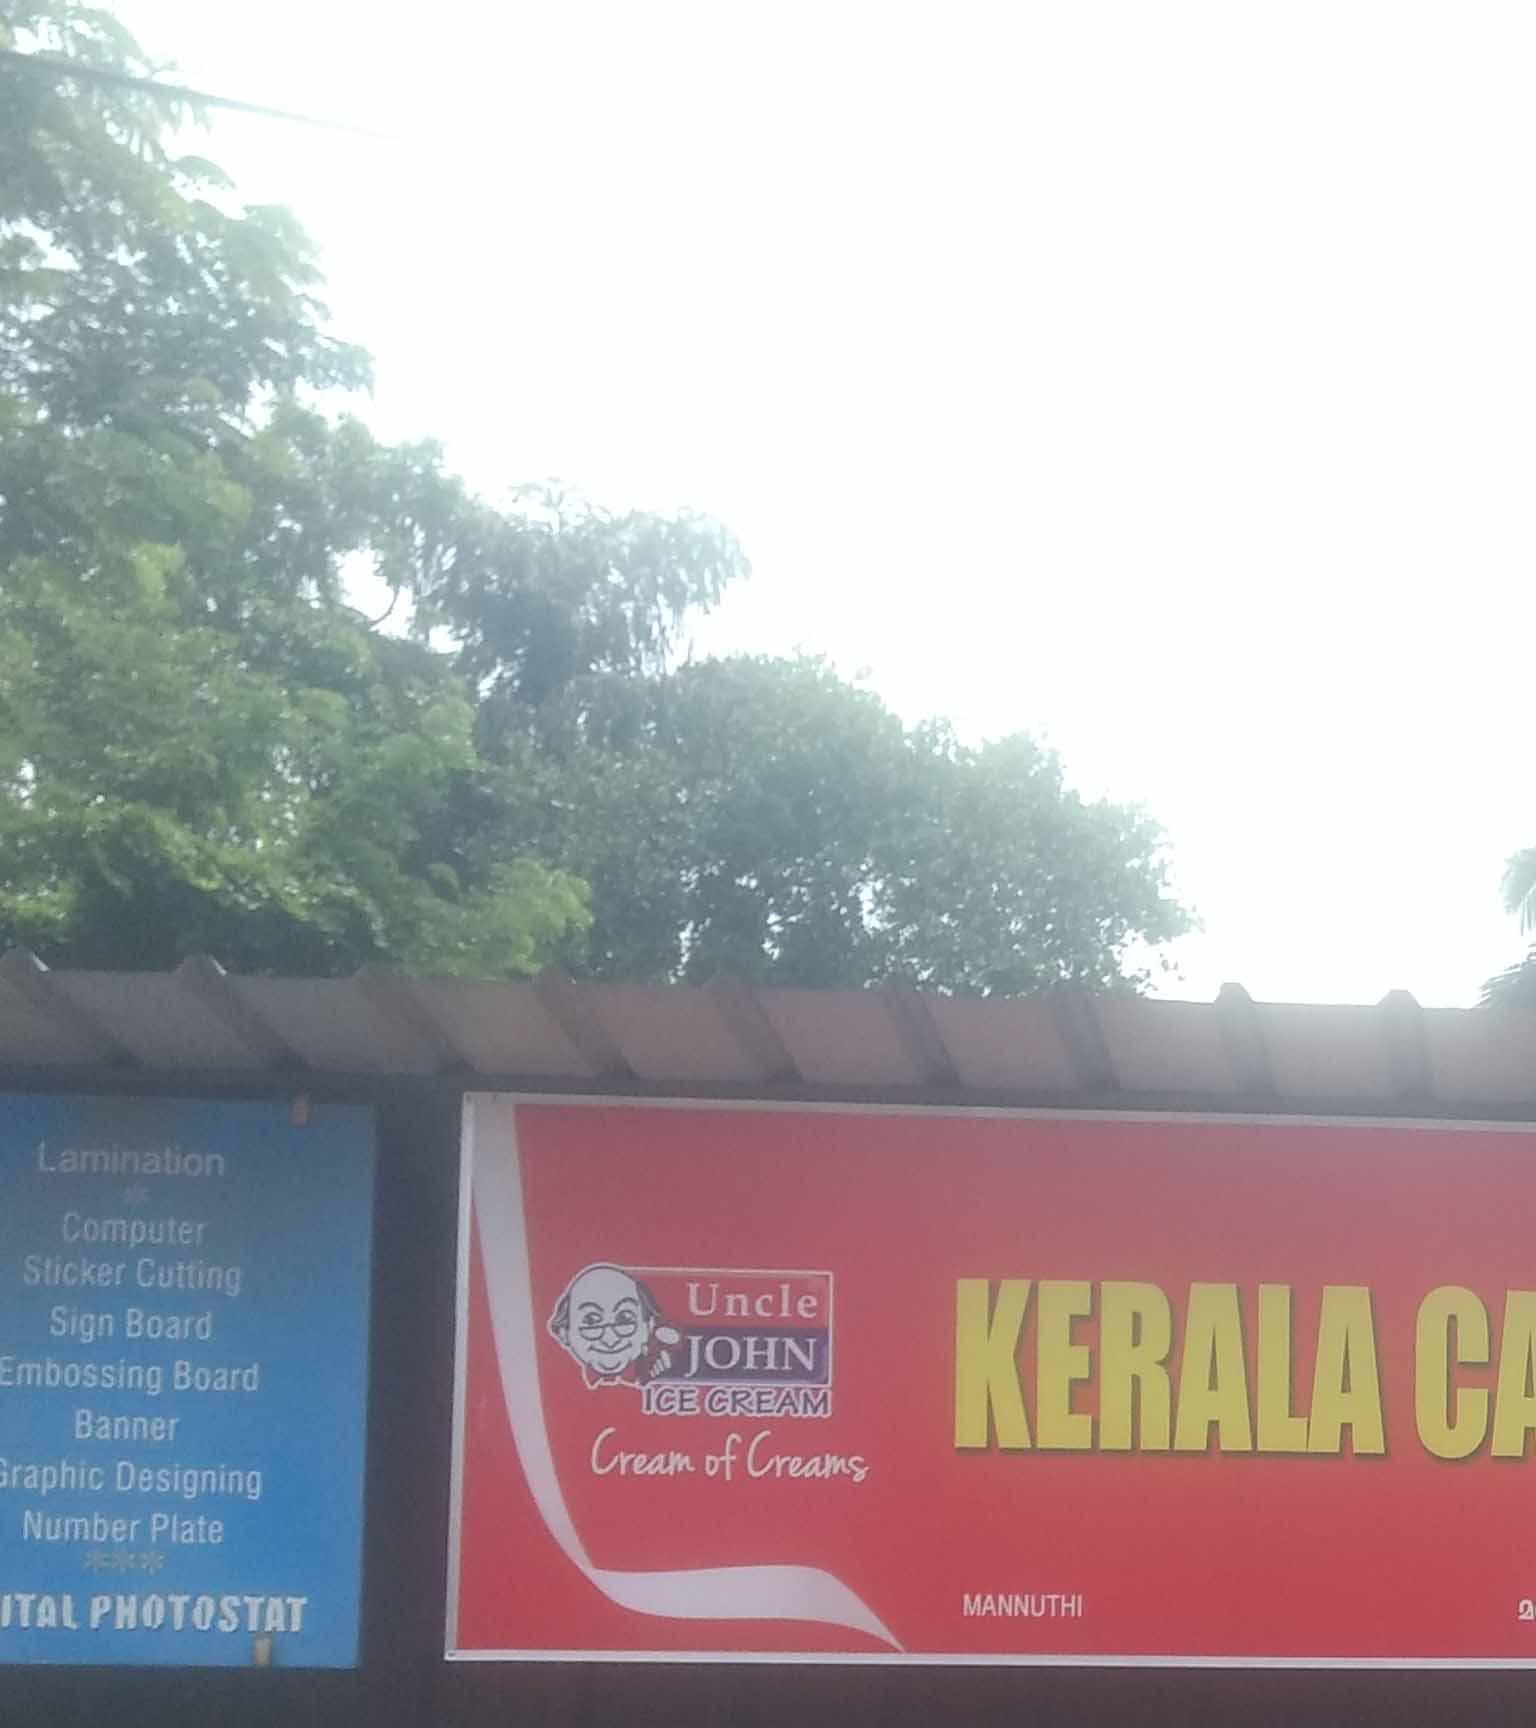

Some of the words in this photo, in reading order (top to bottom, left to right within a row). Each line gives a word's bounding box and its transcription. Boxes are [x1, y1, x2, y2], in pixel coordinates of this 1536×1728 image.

[37, 1141, 225, 1177] Lamination
[62, 1212, 207, 1249] Computer
[24, 1255, 127, 1287] Sticker
[136, 1258, 242, 1297] Cutting
[687, 1282, 818, 1319] Uncle
[50, 1305, 114, 1344] Sign
[127, 1307, 213, 1341] Board
[0, 1355, 163, 1397] Embossing
[173, 1359, 261, 1392] Board
[685, 1335, 818, 1378] JOHN
[954, 1278, 1386, 1457] KERALA
[642, 1386, 698, 1414] ICE
[706, 1387, 831, 1416] CREAM
[74, 1408, 180, 1441] Banner
[591, 1427, 695, 1475] Cream
[704, 1432, 742, 1481] of
[747, 1430, 869, 1483] Creams
[0, 1457, 104, 1495] Graphic
[116, 1460, 262, 1500] Designing
[22, 1509, 140, 1543] Number
[151, 1512, 225, 1544] Plate
[89, 1594, 308, 1634] PHOTOSTAT
[963, 1593, 1083, 1619] MANNUTHI
